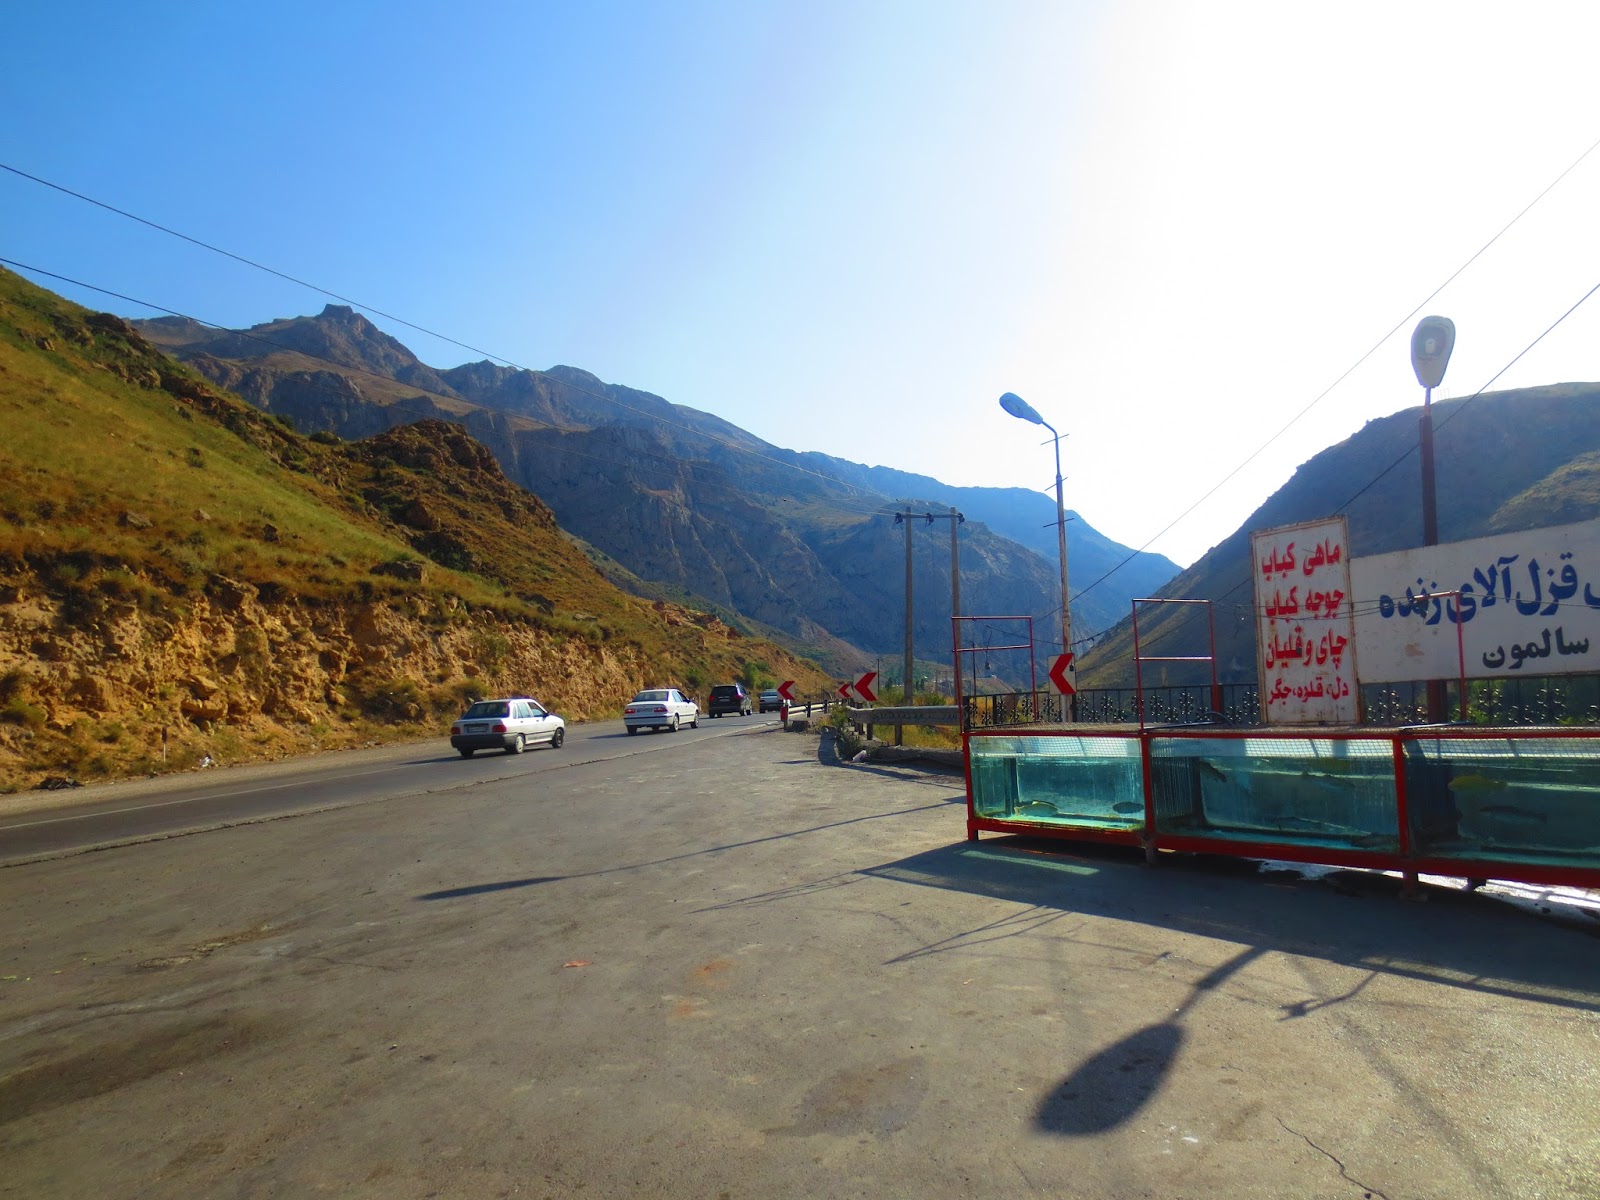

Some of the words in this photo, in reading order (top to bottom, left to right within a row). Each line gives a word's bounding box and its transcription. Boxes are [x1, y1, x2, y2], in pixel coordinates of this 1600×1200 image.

[1261, 541, 1297, 581] کباب
[1302, 537, 1341, 576] ماهی
[1265, 585, 1298, 625] کباب
[1305, 587, 1344, 619] جوجه
[1379, 576, 1442, 626] زنده
[1265, 626, 1302, 669] قلیان
[1316, 627, 1347, 670] چای
[1482, 625, 1589, 669] سالمون
[1268, 678, 1292, 705] جگر
